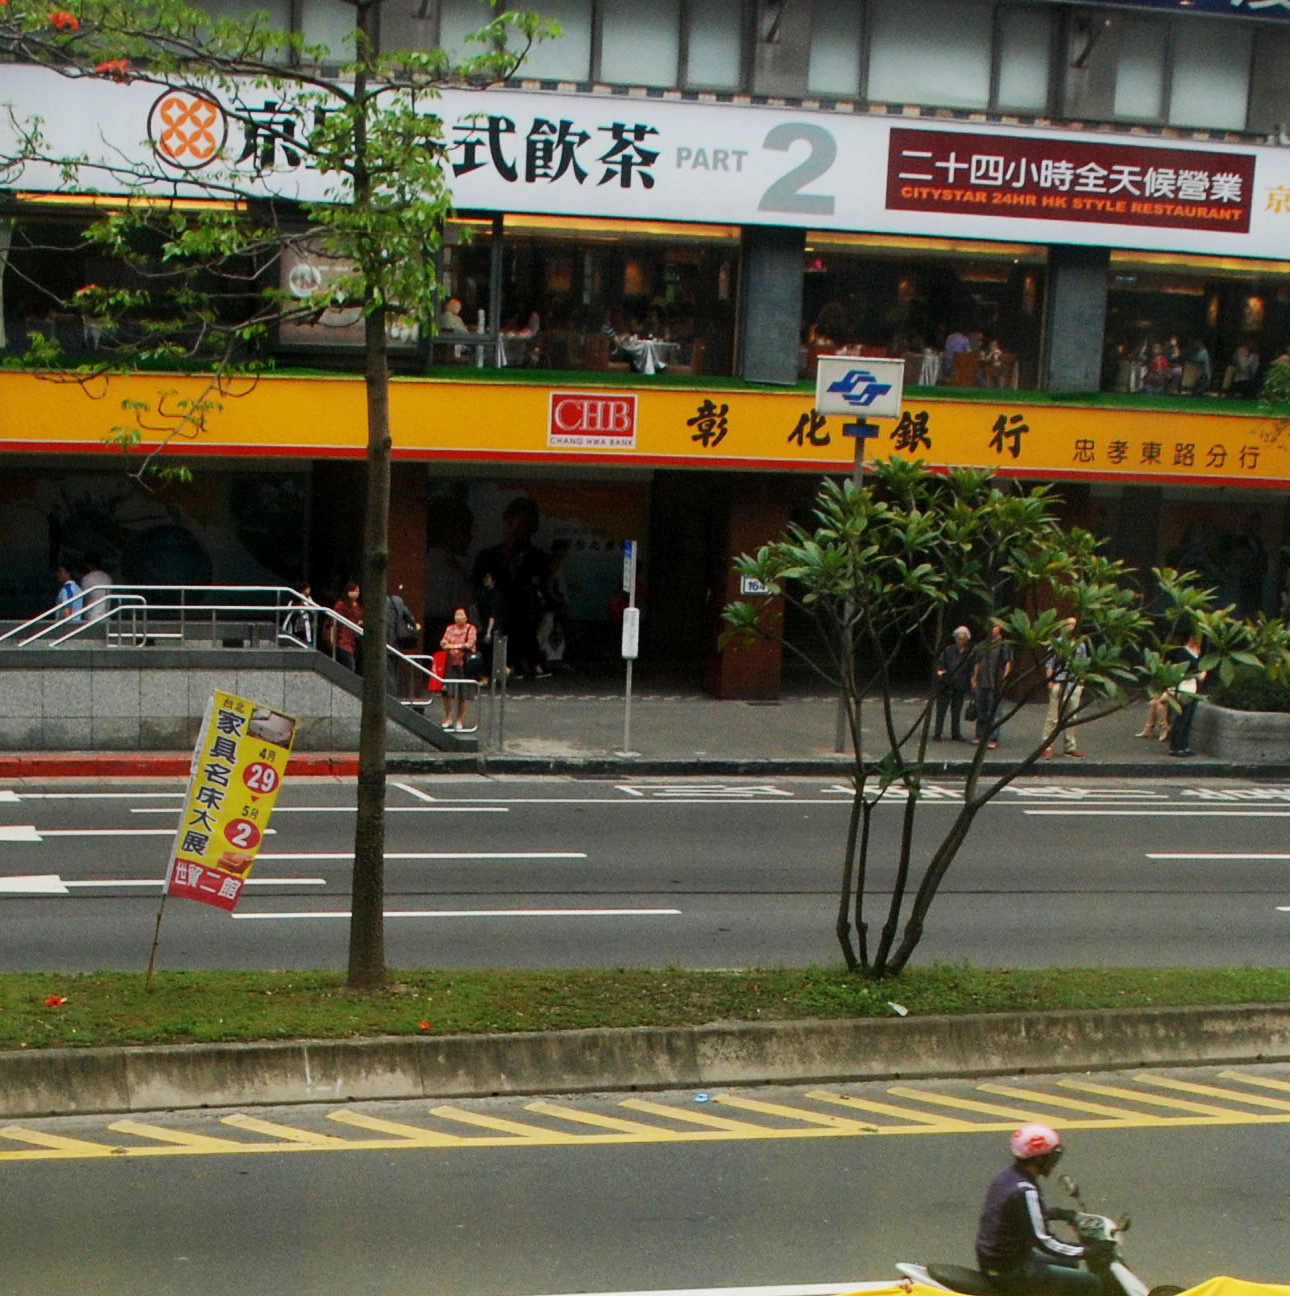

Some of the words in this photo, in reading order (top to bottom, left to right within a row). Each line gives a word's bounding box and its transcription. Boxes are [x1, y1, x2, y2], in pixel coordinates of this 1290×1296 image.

[676, 146, 749, 173] PART
[757, 121, 839, 216] 2
[898, 149, 1243, 204] 二十四小時全天候營業
[901, 186, 988, 204] CITYSTAR
[992, 191, 1038, 209] 24HR
[1042, 195, 1068, 210] HK
[1073, 197, 1127, 214] STYLE
[1131, 200, 1243, 222] RESTAURANT
[554, 398, 631, 432] CHB
[686, 399, 1030, 458] 彰化銀行
[549, 436, 584, 446] CHANG
[1073, 437, 1262, 470] 忠孝東路分行
[181, 708, 247, 858] 家具名床大展
[246, 763, 276, 793] 29
[230, 822, 253, 848] 2
[173, 861, 243, 900] 世貿二館
